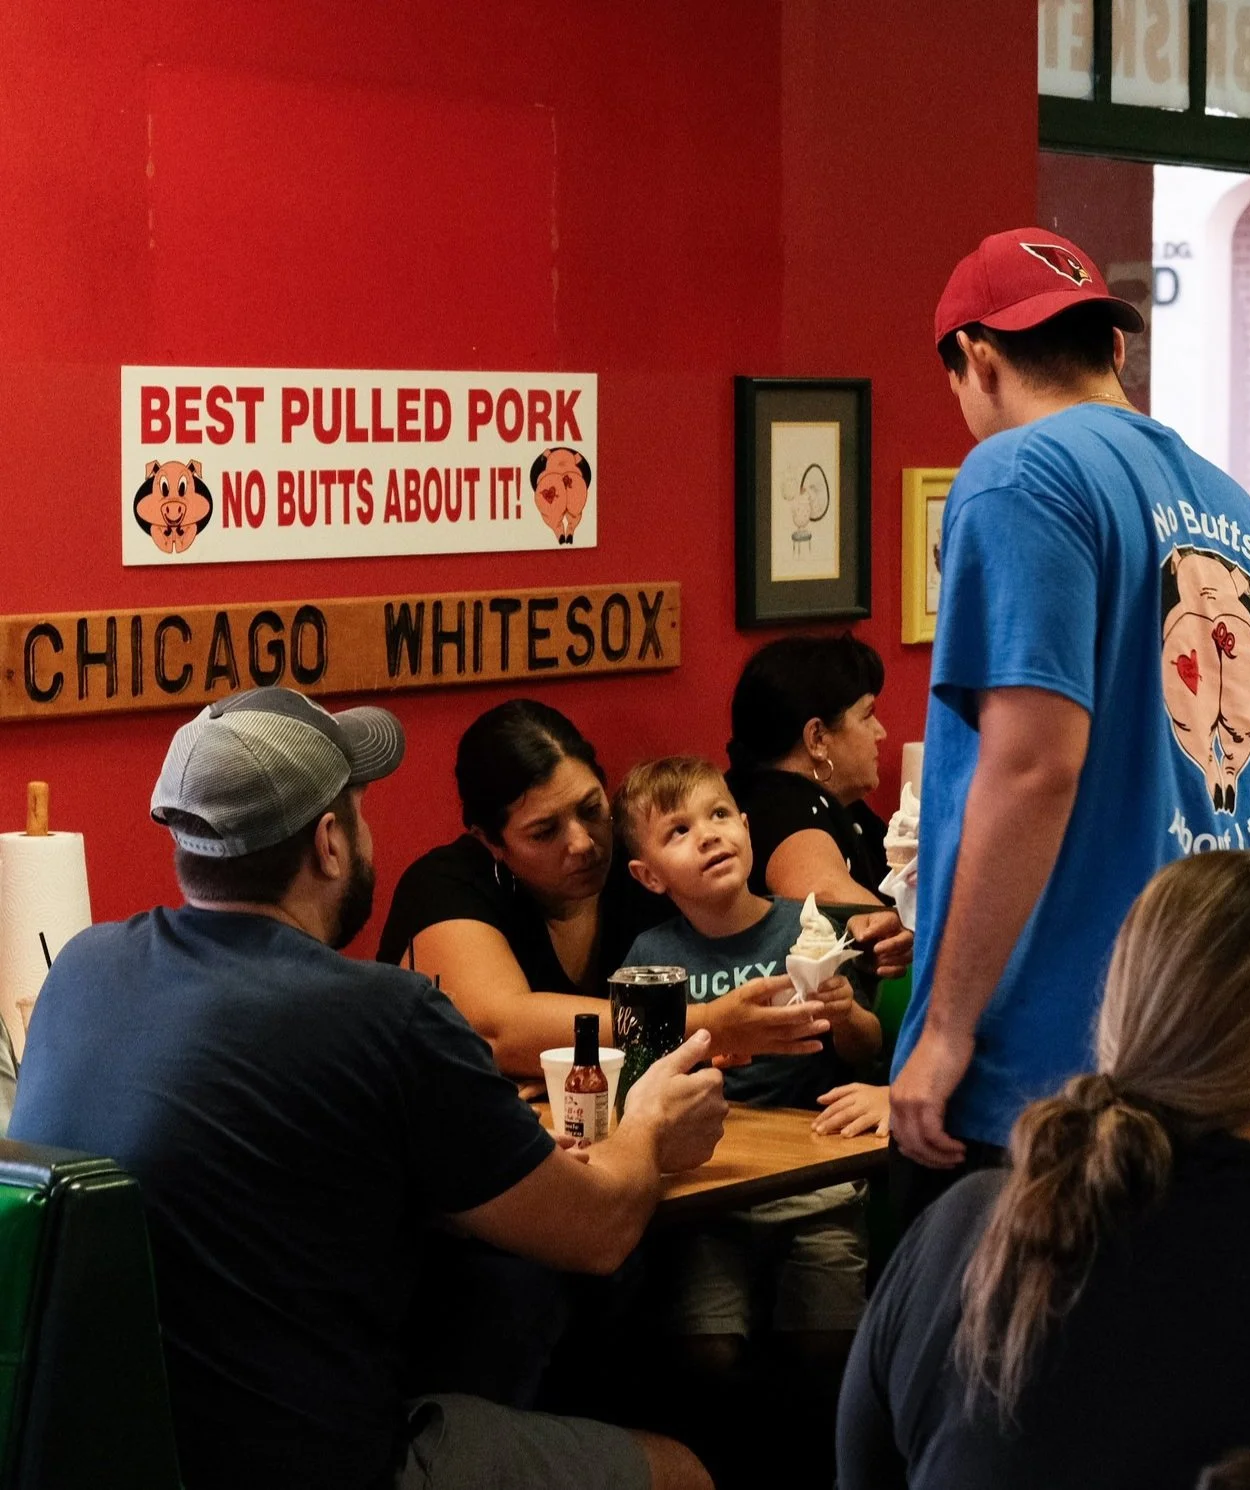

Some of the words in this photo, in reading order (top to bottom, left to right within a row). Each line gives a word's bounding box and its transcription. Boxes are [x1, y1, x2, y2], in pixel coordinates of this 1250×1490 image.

[140, 385, 265, 445] BEST
[281, 387, 452, 444] PULLED
[468, 388, 583, 443] PORK
[222, 469, 266, 529] NO
[277, 467, 374, 527] BUTTS
[383, 467, 481, 524] ABOUT
[490, 467, 522, 520] IT!
[1152, 502, 1179, 543] No
[24, 605, 329, 702] CHICAGO
[384, 591, 665, 677] WHITESOX
[689, 961, 777, 999] UCKY
